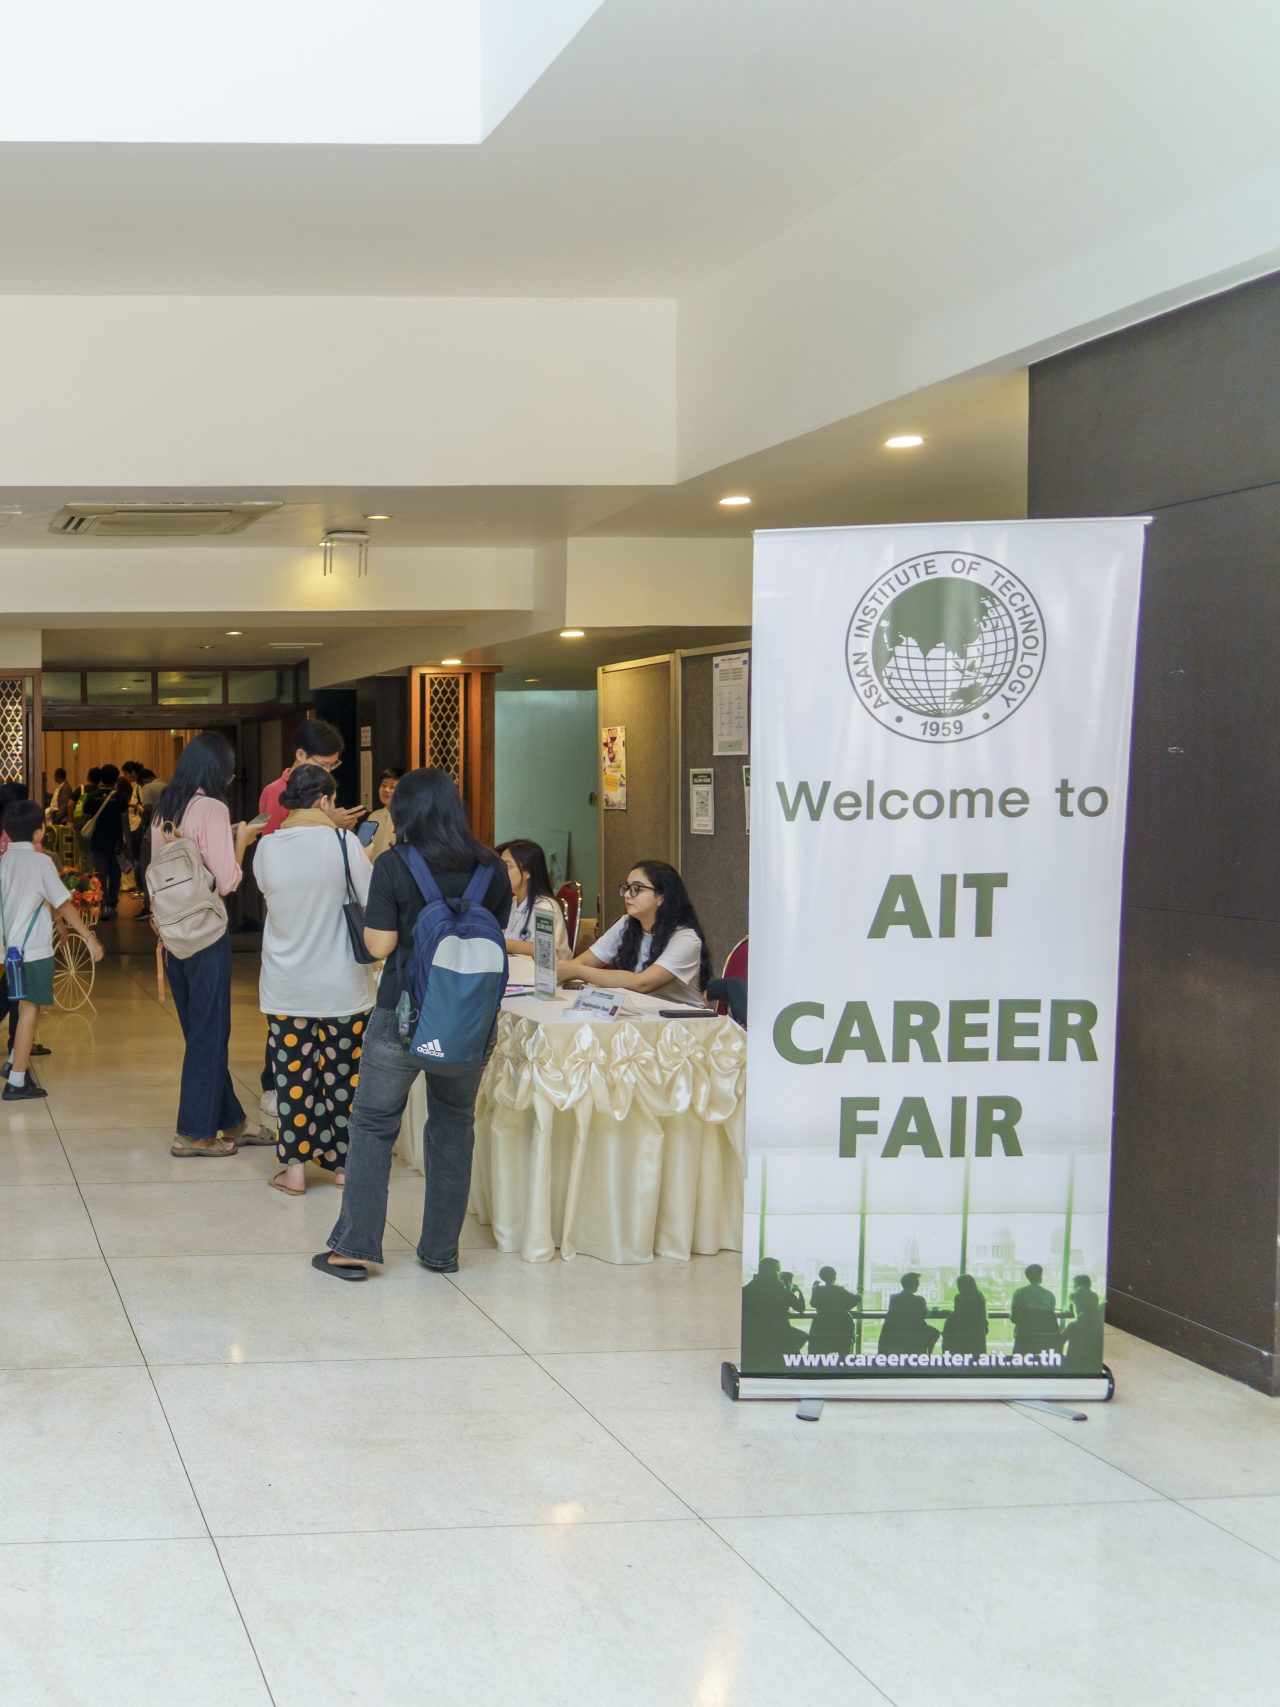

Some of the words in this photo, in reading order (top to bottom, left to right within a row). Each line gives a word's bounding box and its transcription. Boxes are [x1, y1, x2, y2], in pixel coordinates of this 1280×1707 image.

[950, 558, 981, 576] OF
[853, 559, 938, 639] INSTITUTE
[989, 570, 1040, 708] TECHNOLOGY
[852, 652, 890, 710] ASIAN
[920, 719, 964, 737] 1959
[776, 780, 1030, 821] Welcome
[1055, 779, 1109, 817] to
[867, 873, 1008, 939] AIT
[417, 1046, 445, 1058] adidas
[772, 999, 1099, 1065] CAREER
[839, 1095, 1023, 1158] FAIR
[783, 1349, 1062, 1367] www.careercenter.ait.ac.th
